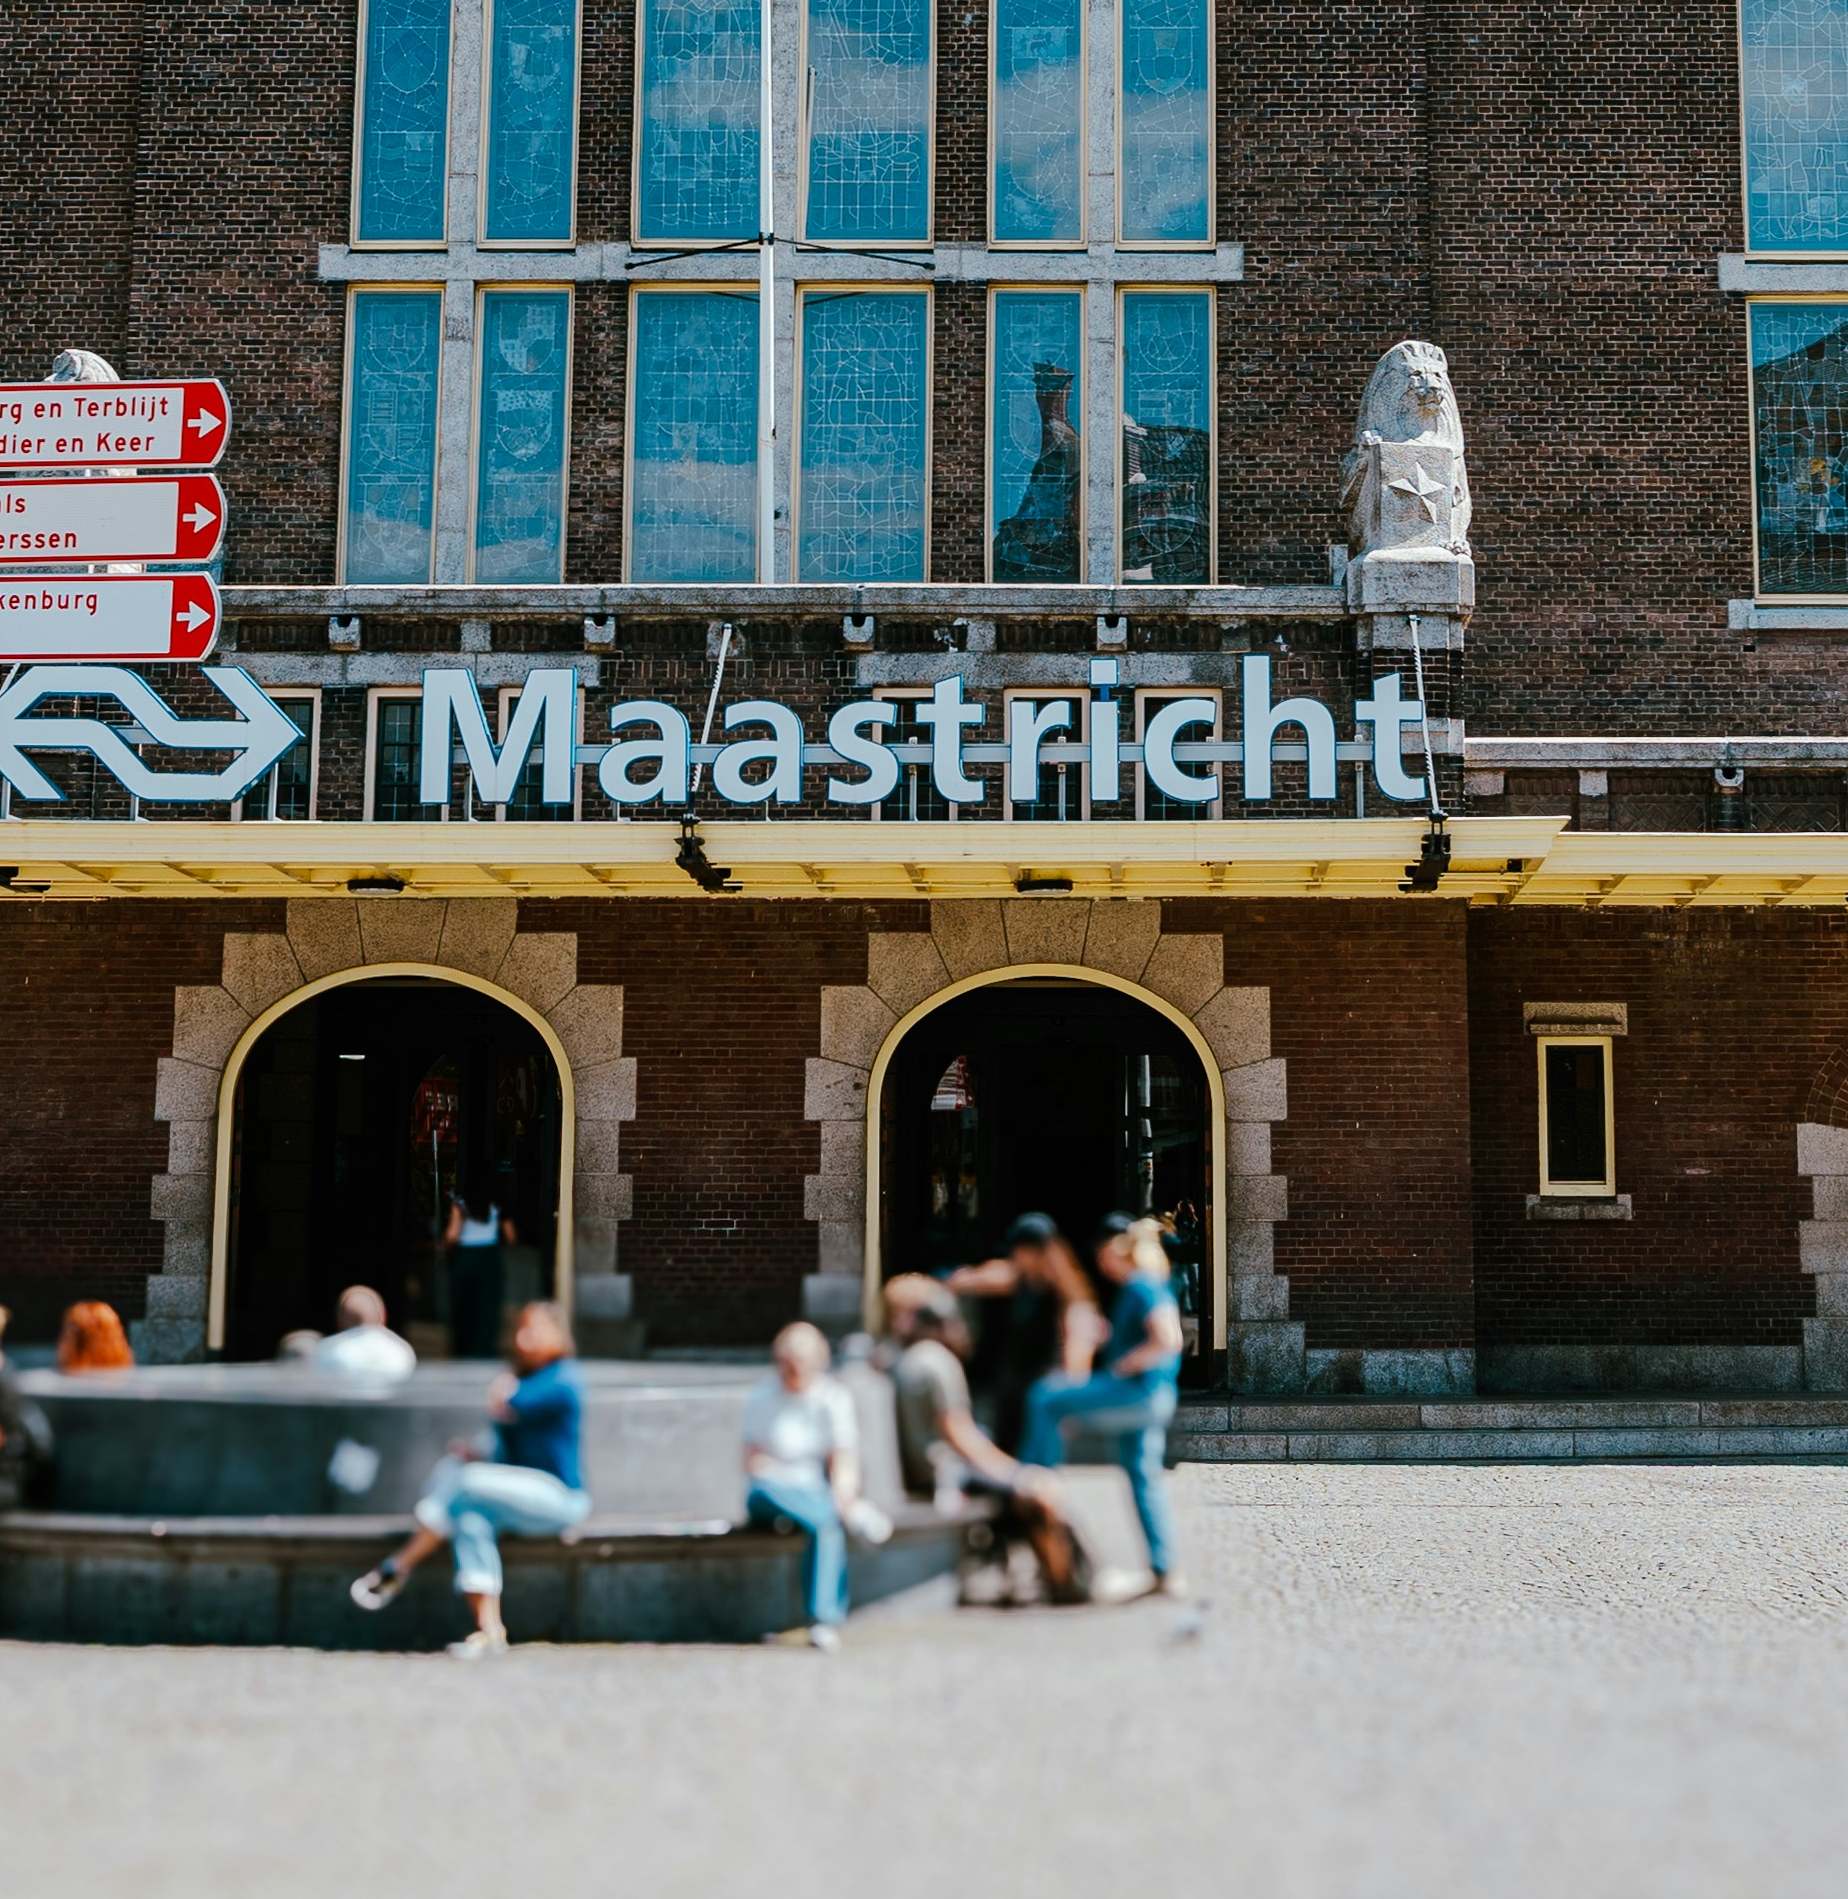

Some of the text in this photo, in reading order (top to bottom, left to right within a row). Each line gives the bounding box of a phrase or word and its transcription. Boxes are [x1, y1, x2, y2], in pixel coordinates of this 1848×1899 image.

[33, 402, 62, 419] en
[74, 396, 169, 422] Terblijt
[55, 437, 84, 454] en
[96, 432, 155, 453] Keer
[419, 653, 1427, 804] Maastricht
